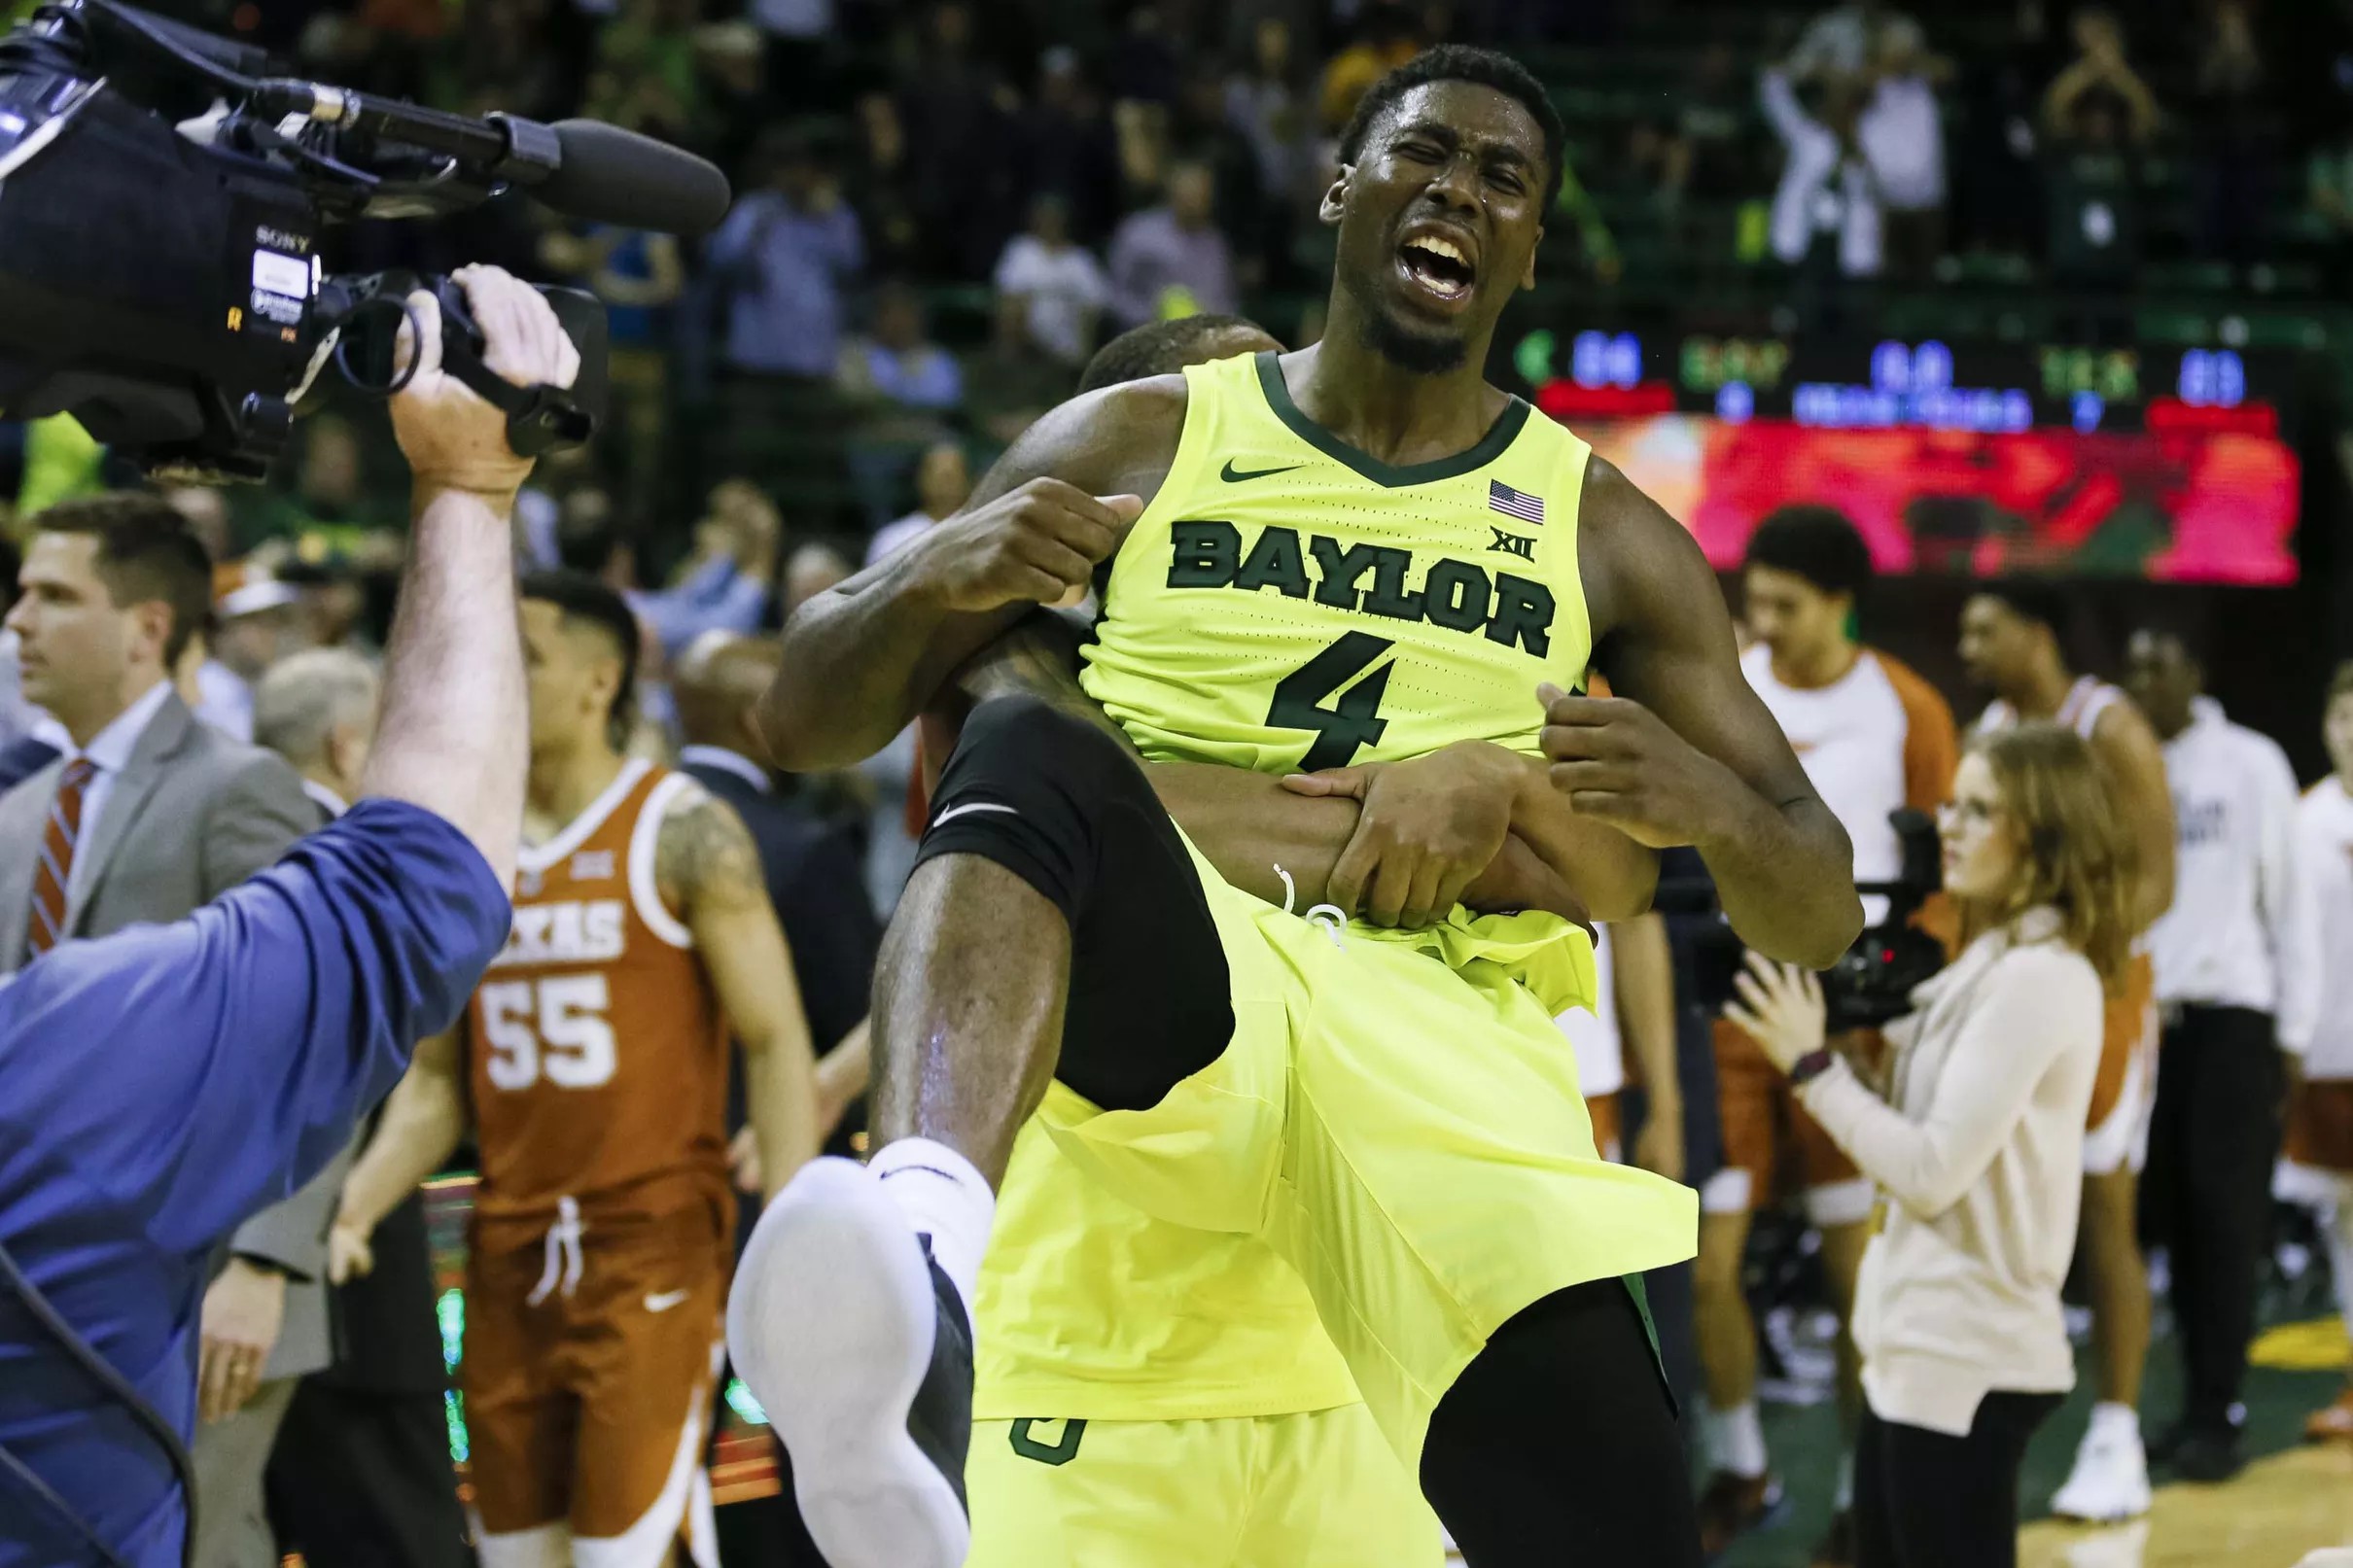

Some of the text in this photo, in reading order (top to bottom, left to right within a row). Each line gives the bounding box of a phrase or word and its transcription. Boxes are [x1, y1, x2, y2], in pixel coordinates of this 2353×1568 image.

[256, 225, 309, 254] SONY
[1166, 520, 1557, 659] BAYLOR
[1487, 525, 1538, 564] XII
[1264, 630, 1396, 773] 4
[480, 973, 618, 1092] 55
